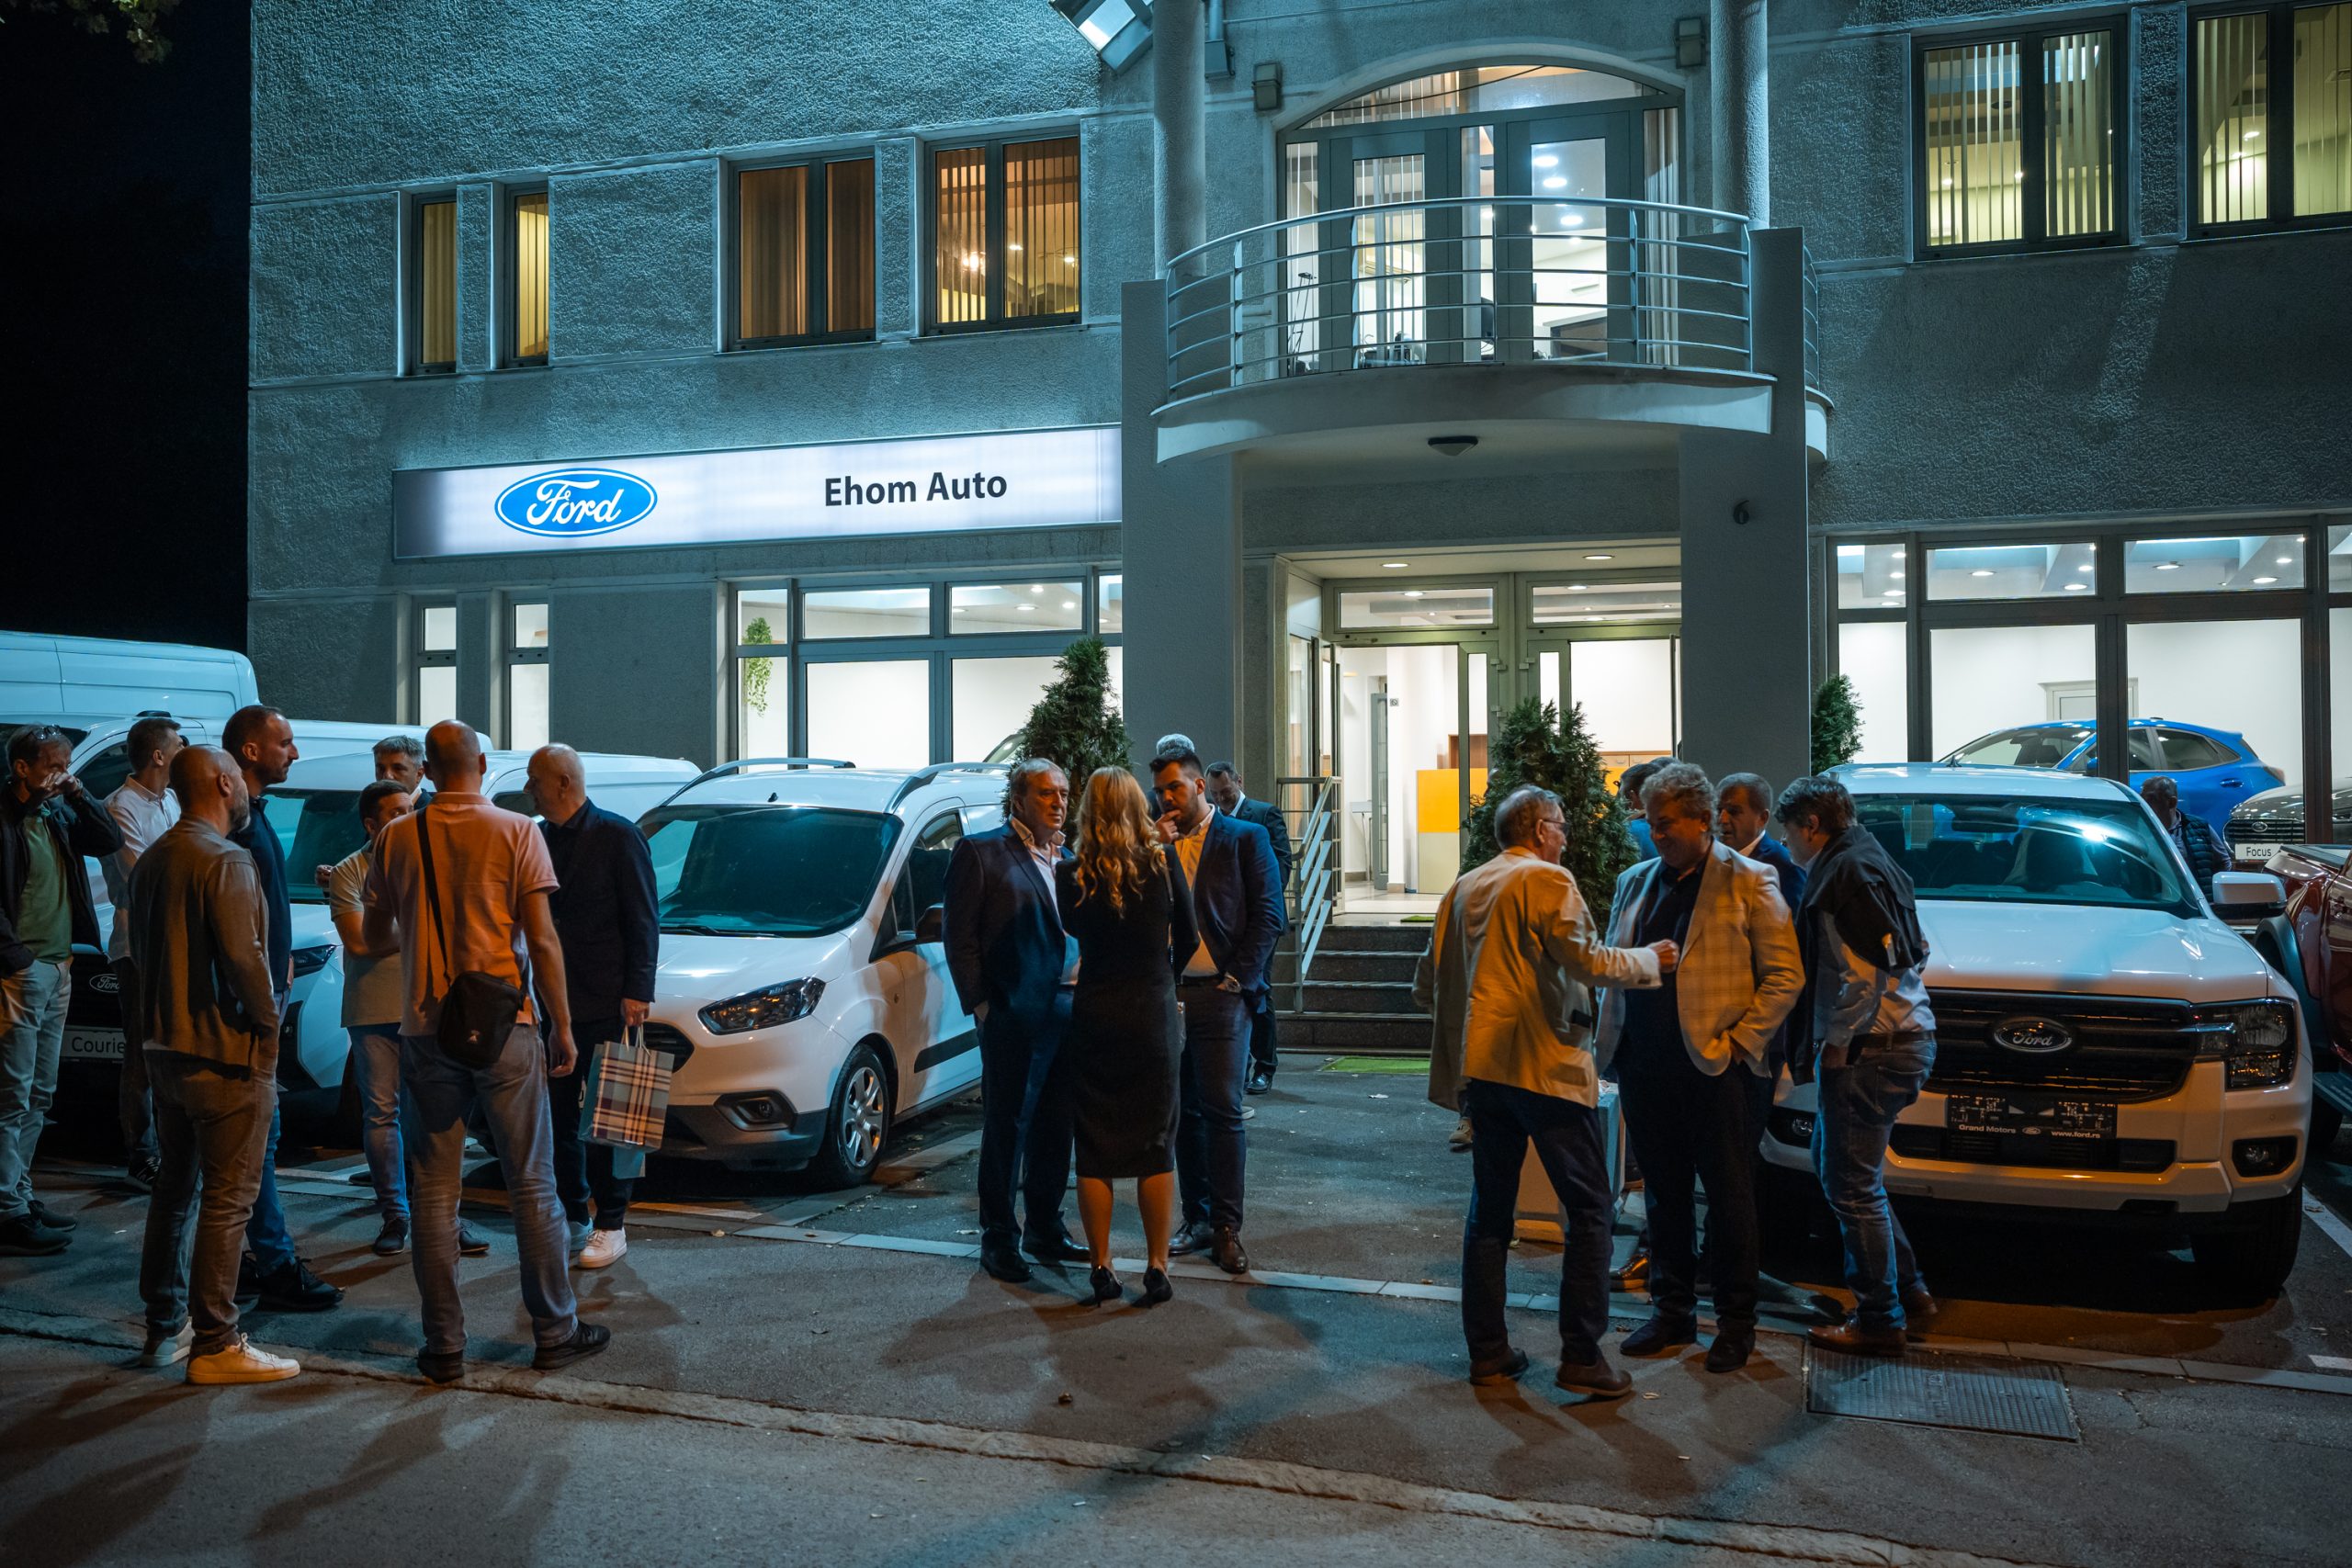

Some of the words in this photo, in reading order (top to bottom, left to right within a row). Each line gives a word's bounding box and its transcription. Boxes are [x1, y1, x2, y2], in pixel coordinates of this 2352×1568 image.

[825, 475, 917, 506] Ehom
[926, 471, 1008, 501] Auto
[526, 479, 625, 525] Ford
[2245, 846, 2272, 857] Focus
[72, 1036, 126, 1054] Courie
[1958, 1123, 1984, 1132] Grand
[1985, 1125, 2017, 1134] Motors
[2051, 1130, 2101, 1139] www.ford.rs
